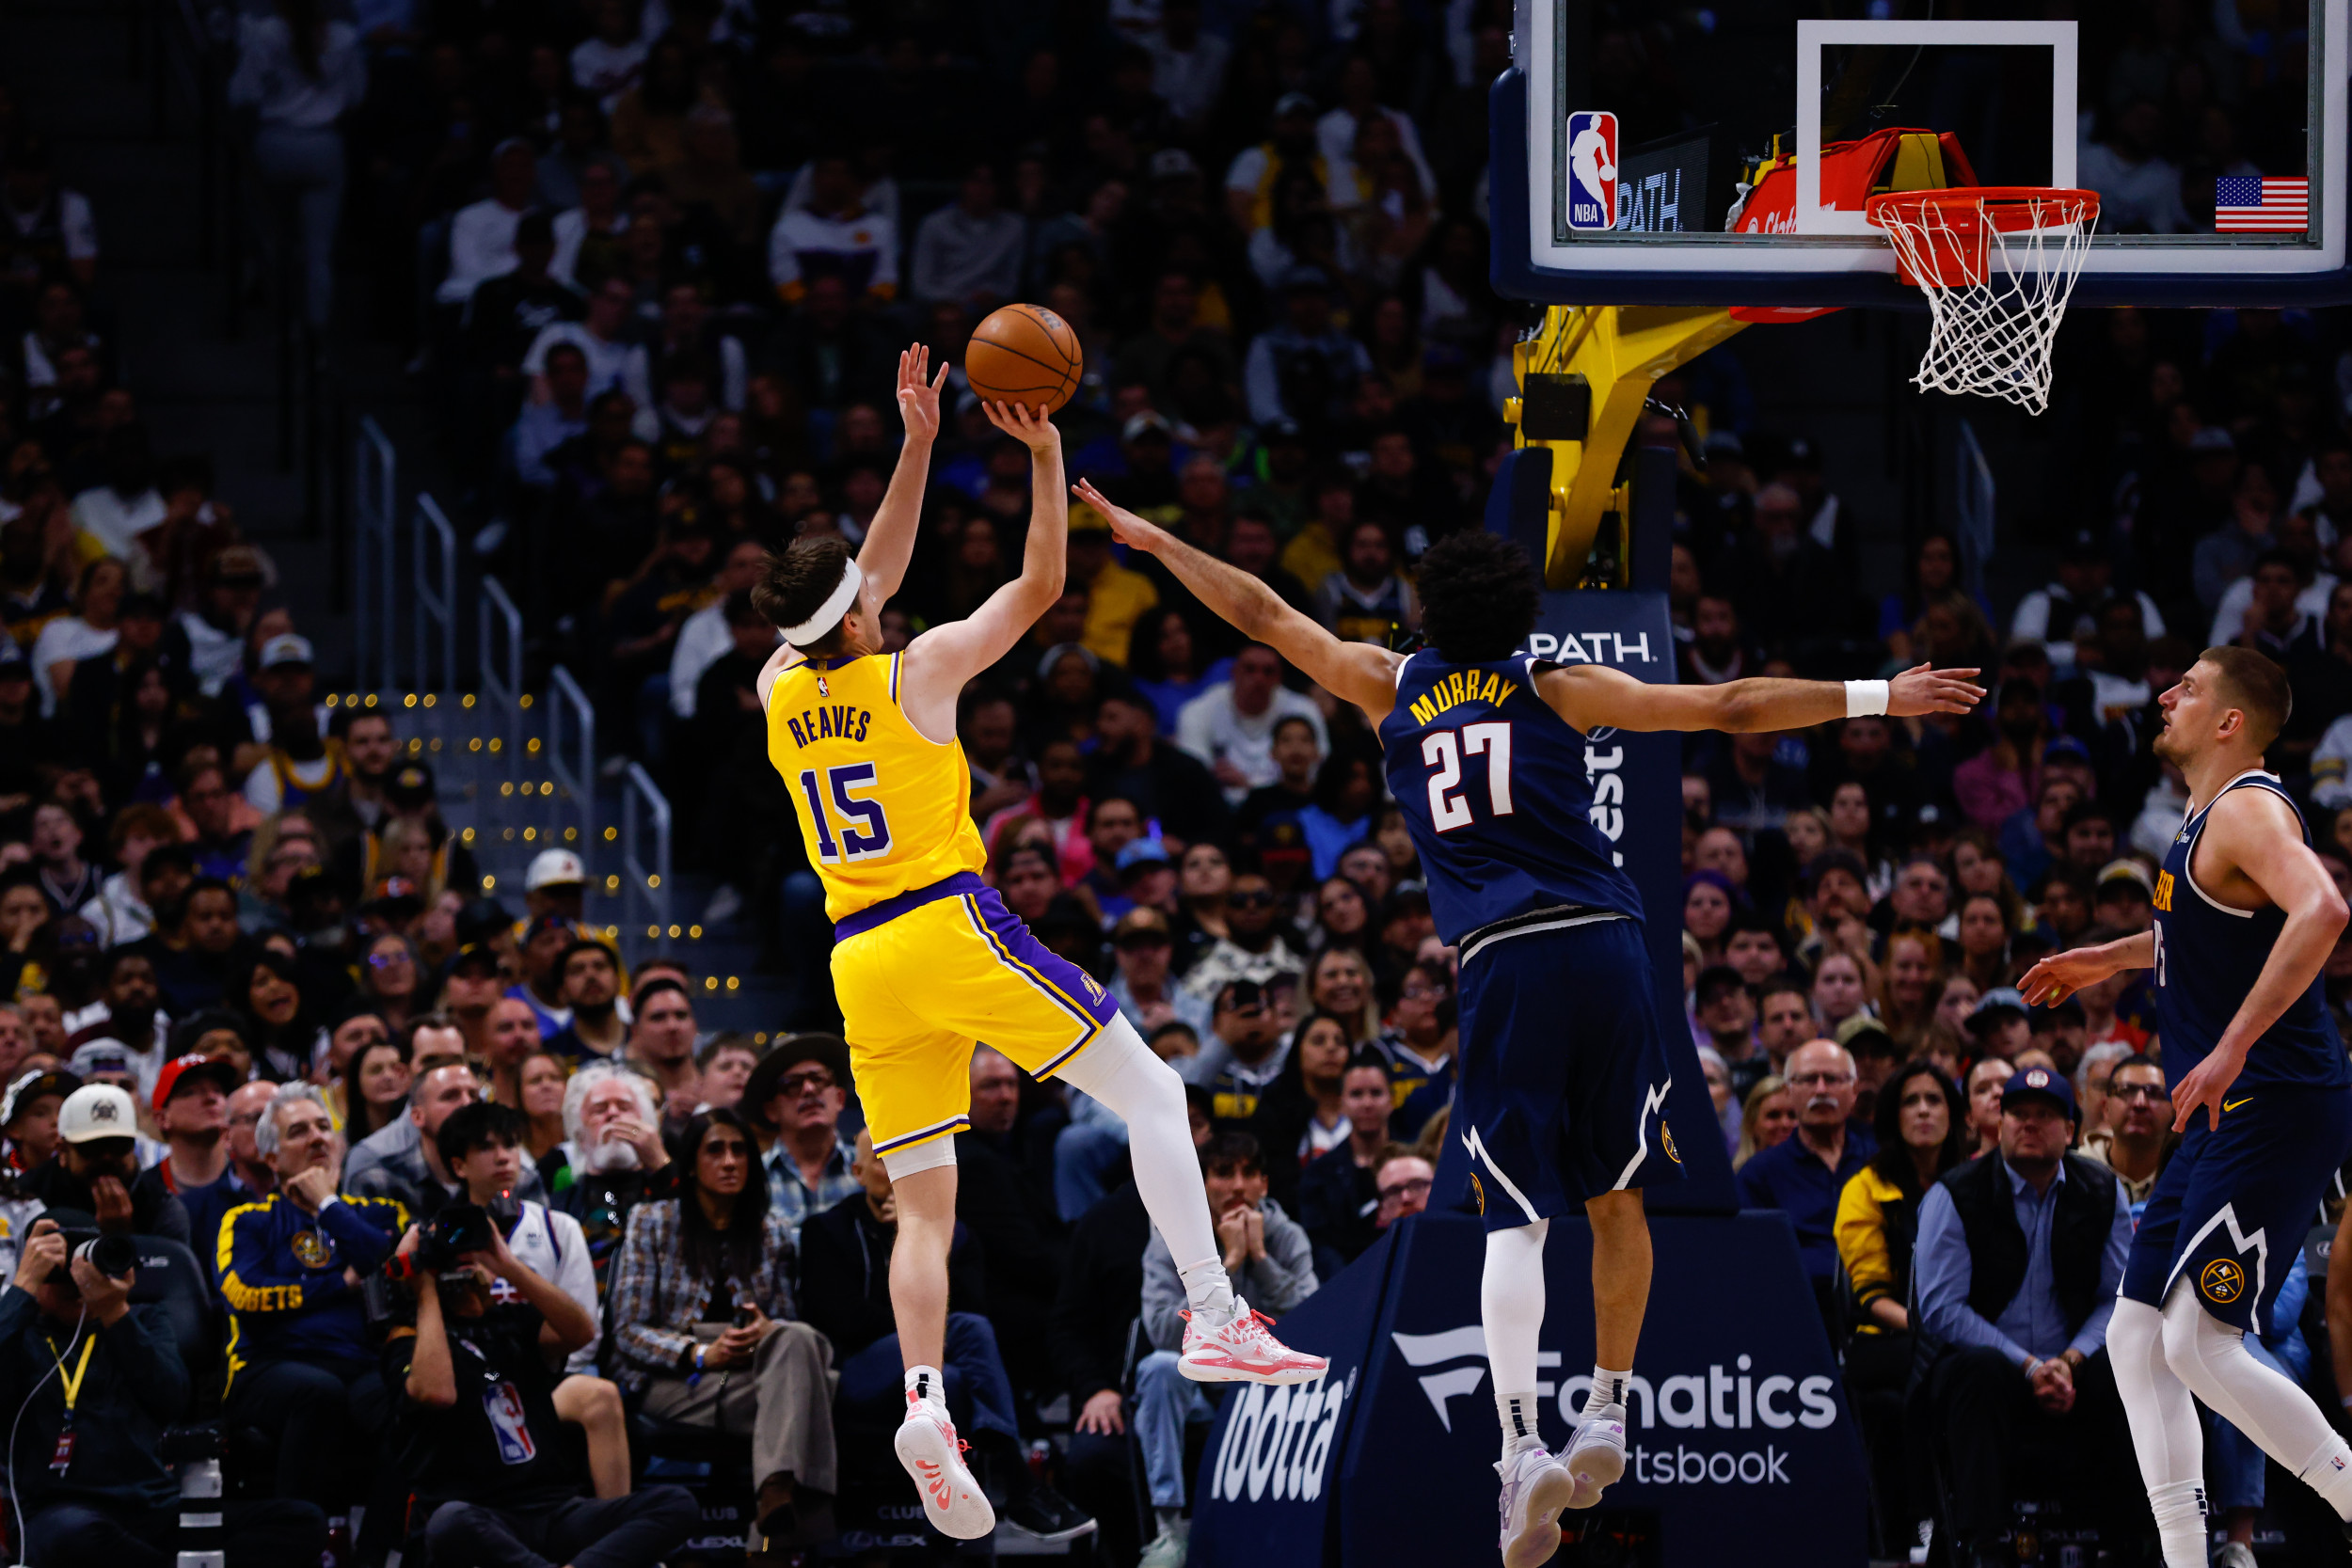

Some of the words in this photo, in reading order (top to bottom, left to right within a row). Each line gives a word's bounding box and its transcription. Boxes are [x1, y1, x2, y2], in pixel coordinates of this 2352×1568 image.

[1574, 204, 1598, 223] NBA
[1408, 668, 1519, 727] MURRAY
[787, 705, 872, 749] REAVES
[1420, 720, 1516, 836] 27
[798, 760, 895, 865] 15
[1584, 745, 1625, 868] est
[702, 1506, 739, 1521] LUB
[686, 1535, 747, 1549] LEXU
